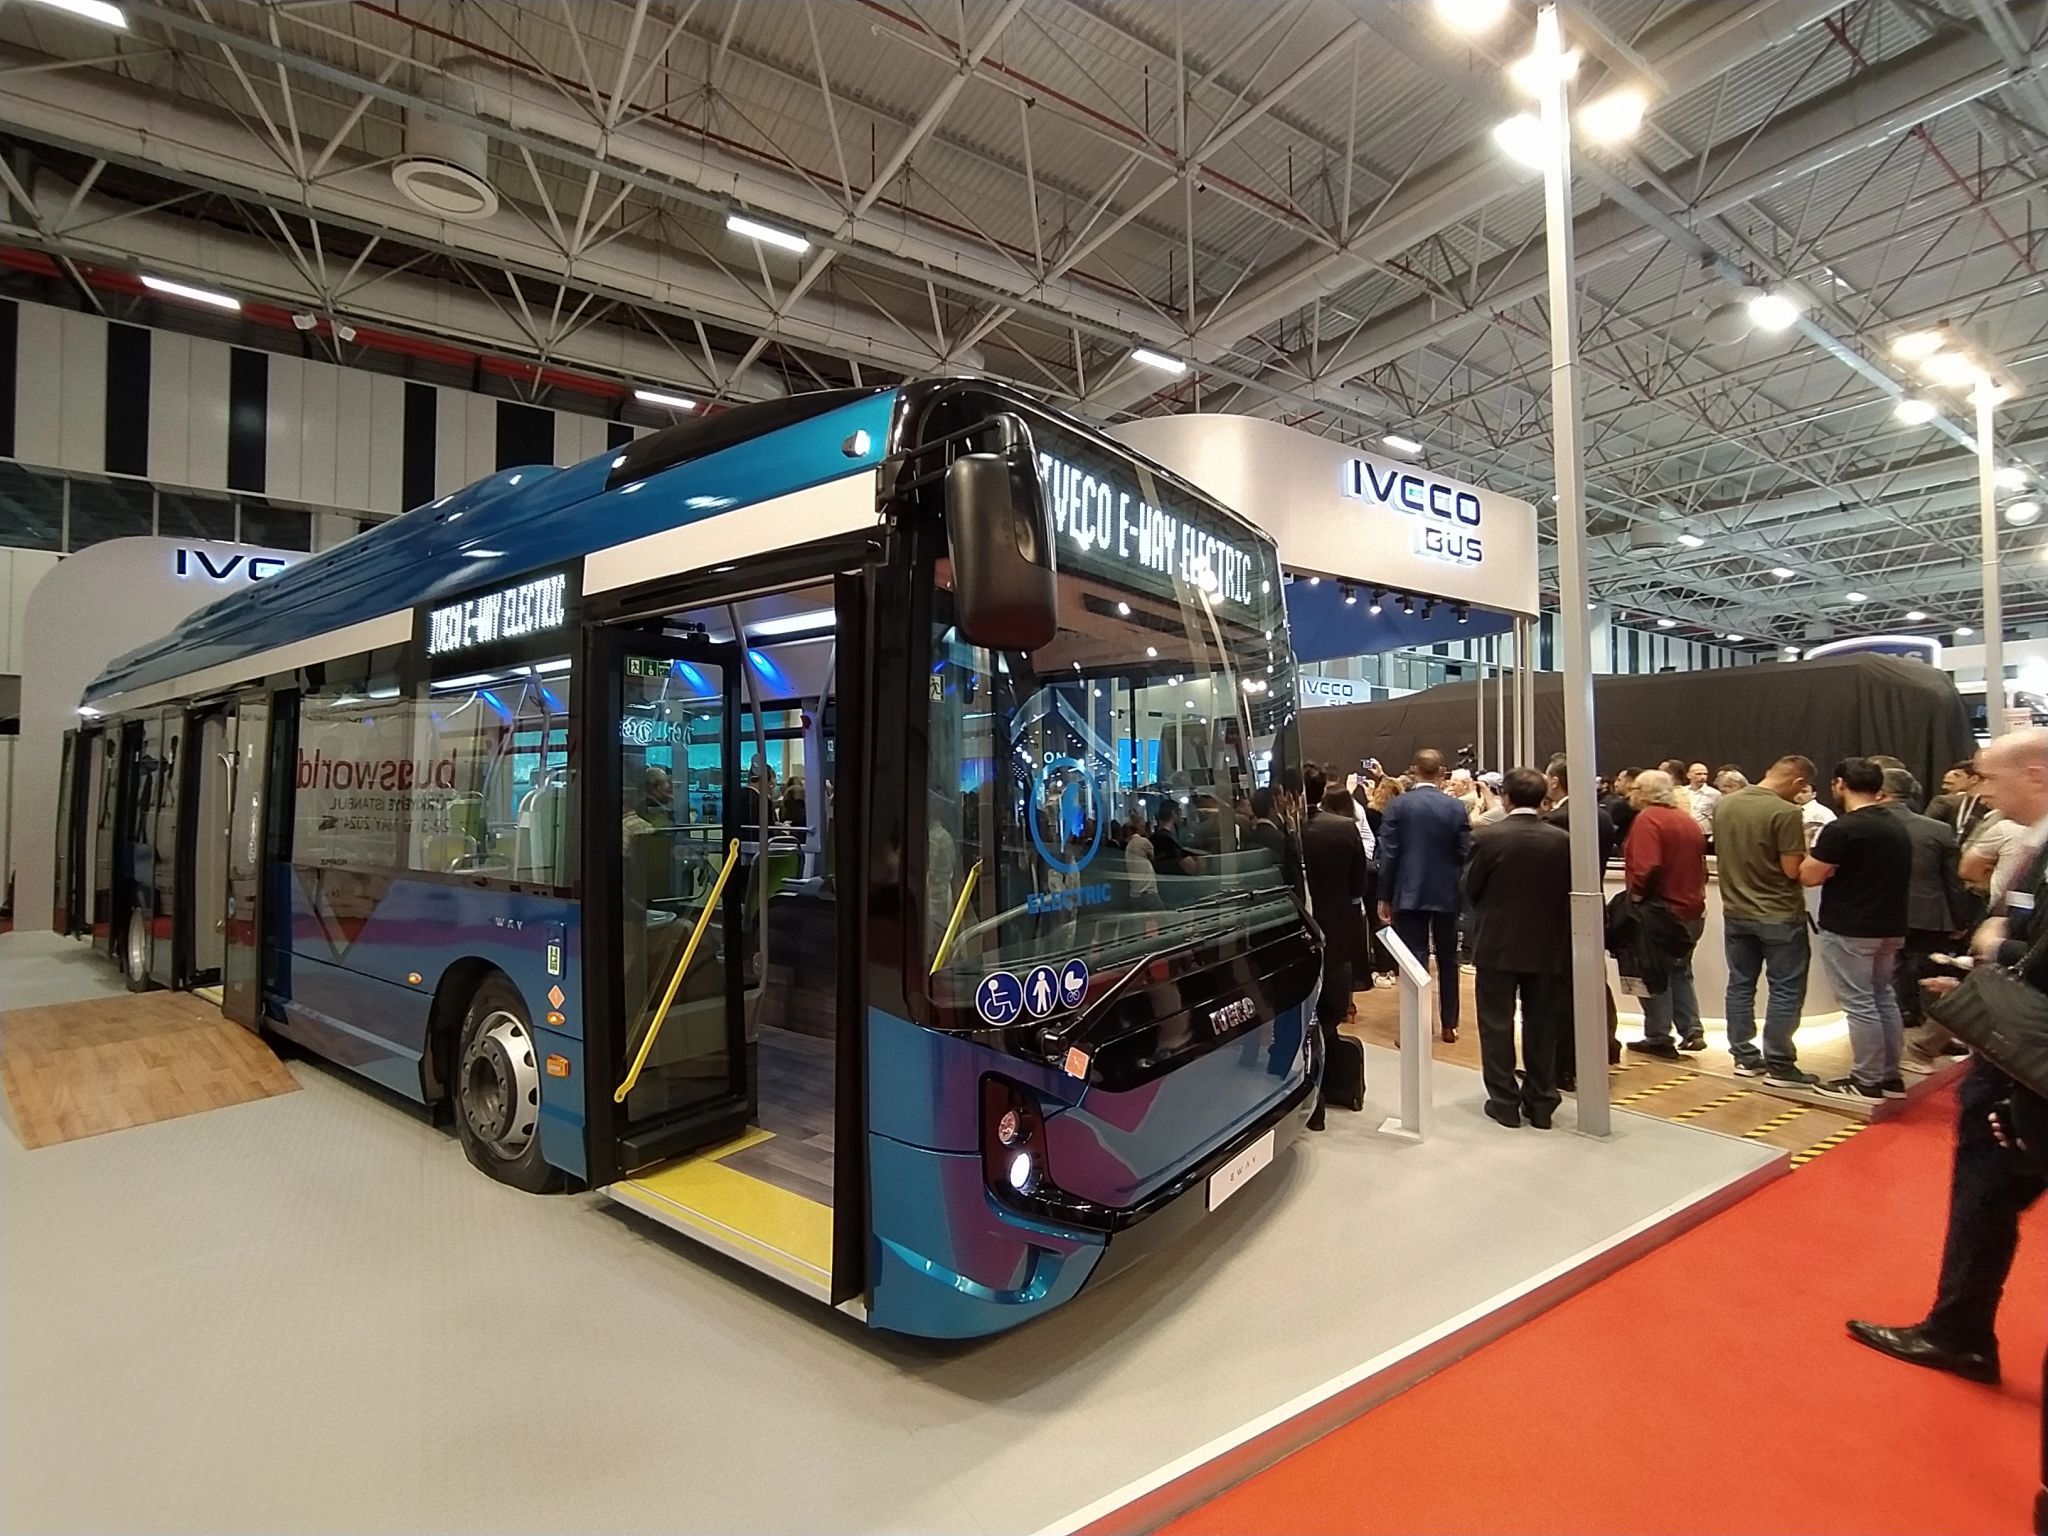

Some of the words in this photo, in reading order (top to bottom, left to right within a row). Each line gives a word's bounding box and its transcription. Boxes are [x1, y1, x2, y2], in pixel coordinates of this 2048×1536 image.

[1346, 459, 1481, 527] IVECO
[1118, 492, 1176, 576] E-WAY
[1179, 523, 1252, 606] ELECTRIC
[1423, 527, 1483, 563] BUS
[176, 548, 286, 582] IVE
[501, 573, 566, 638] ELECTRIC
[1302, 679, 1353, 697] IVECO
[1027, 883, 1112, 915] ELECTRIC
[1209, 996, 1256, 1036] IVECO
